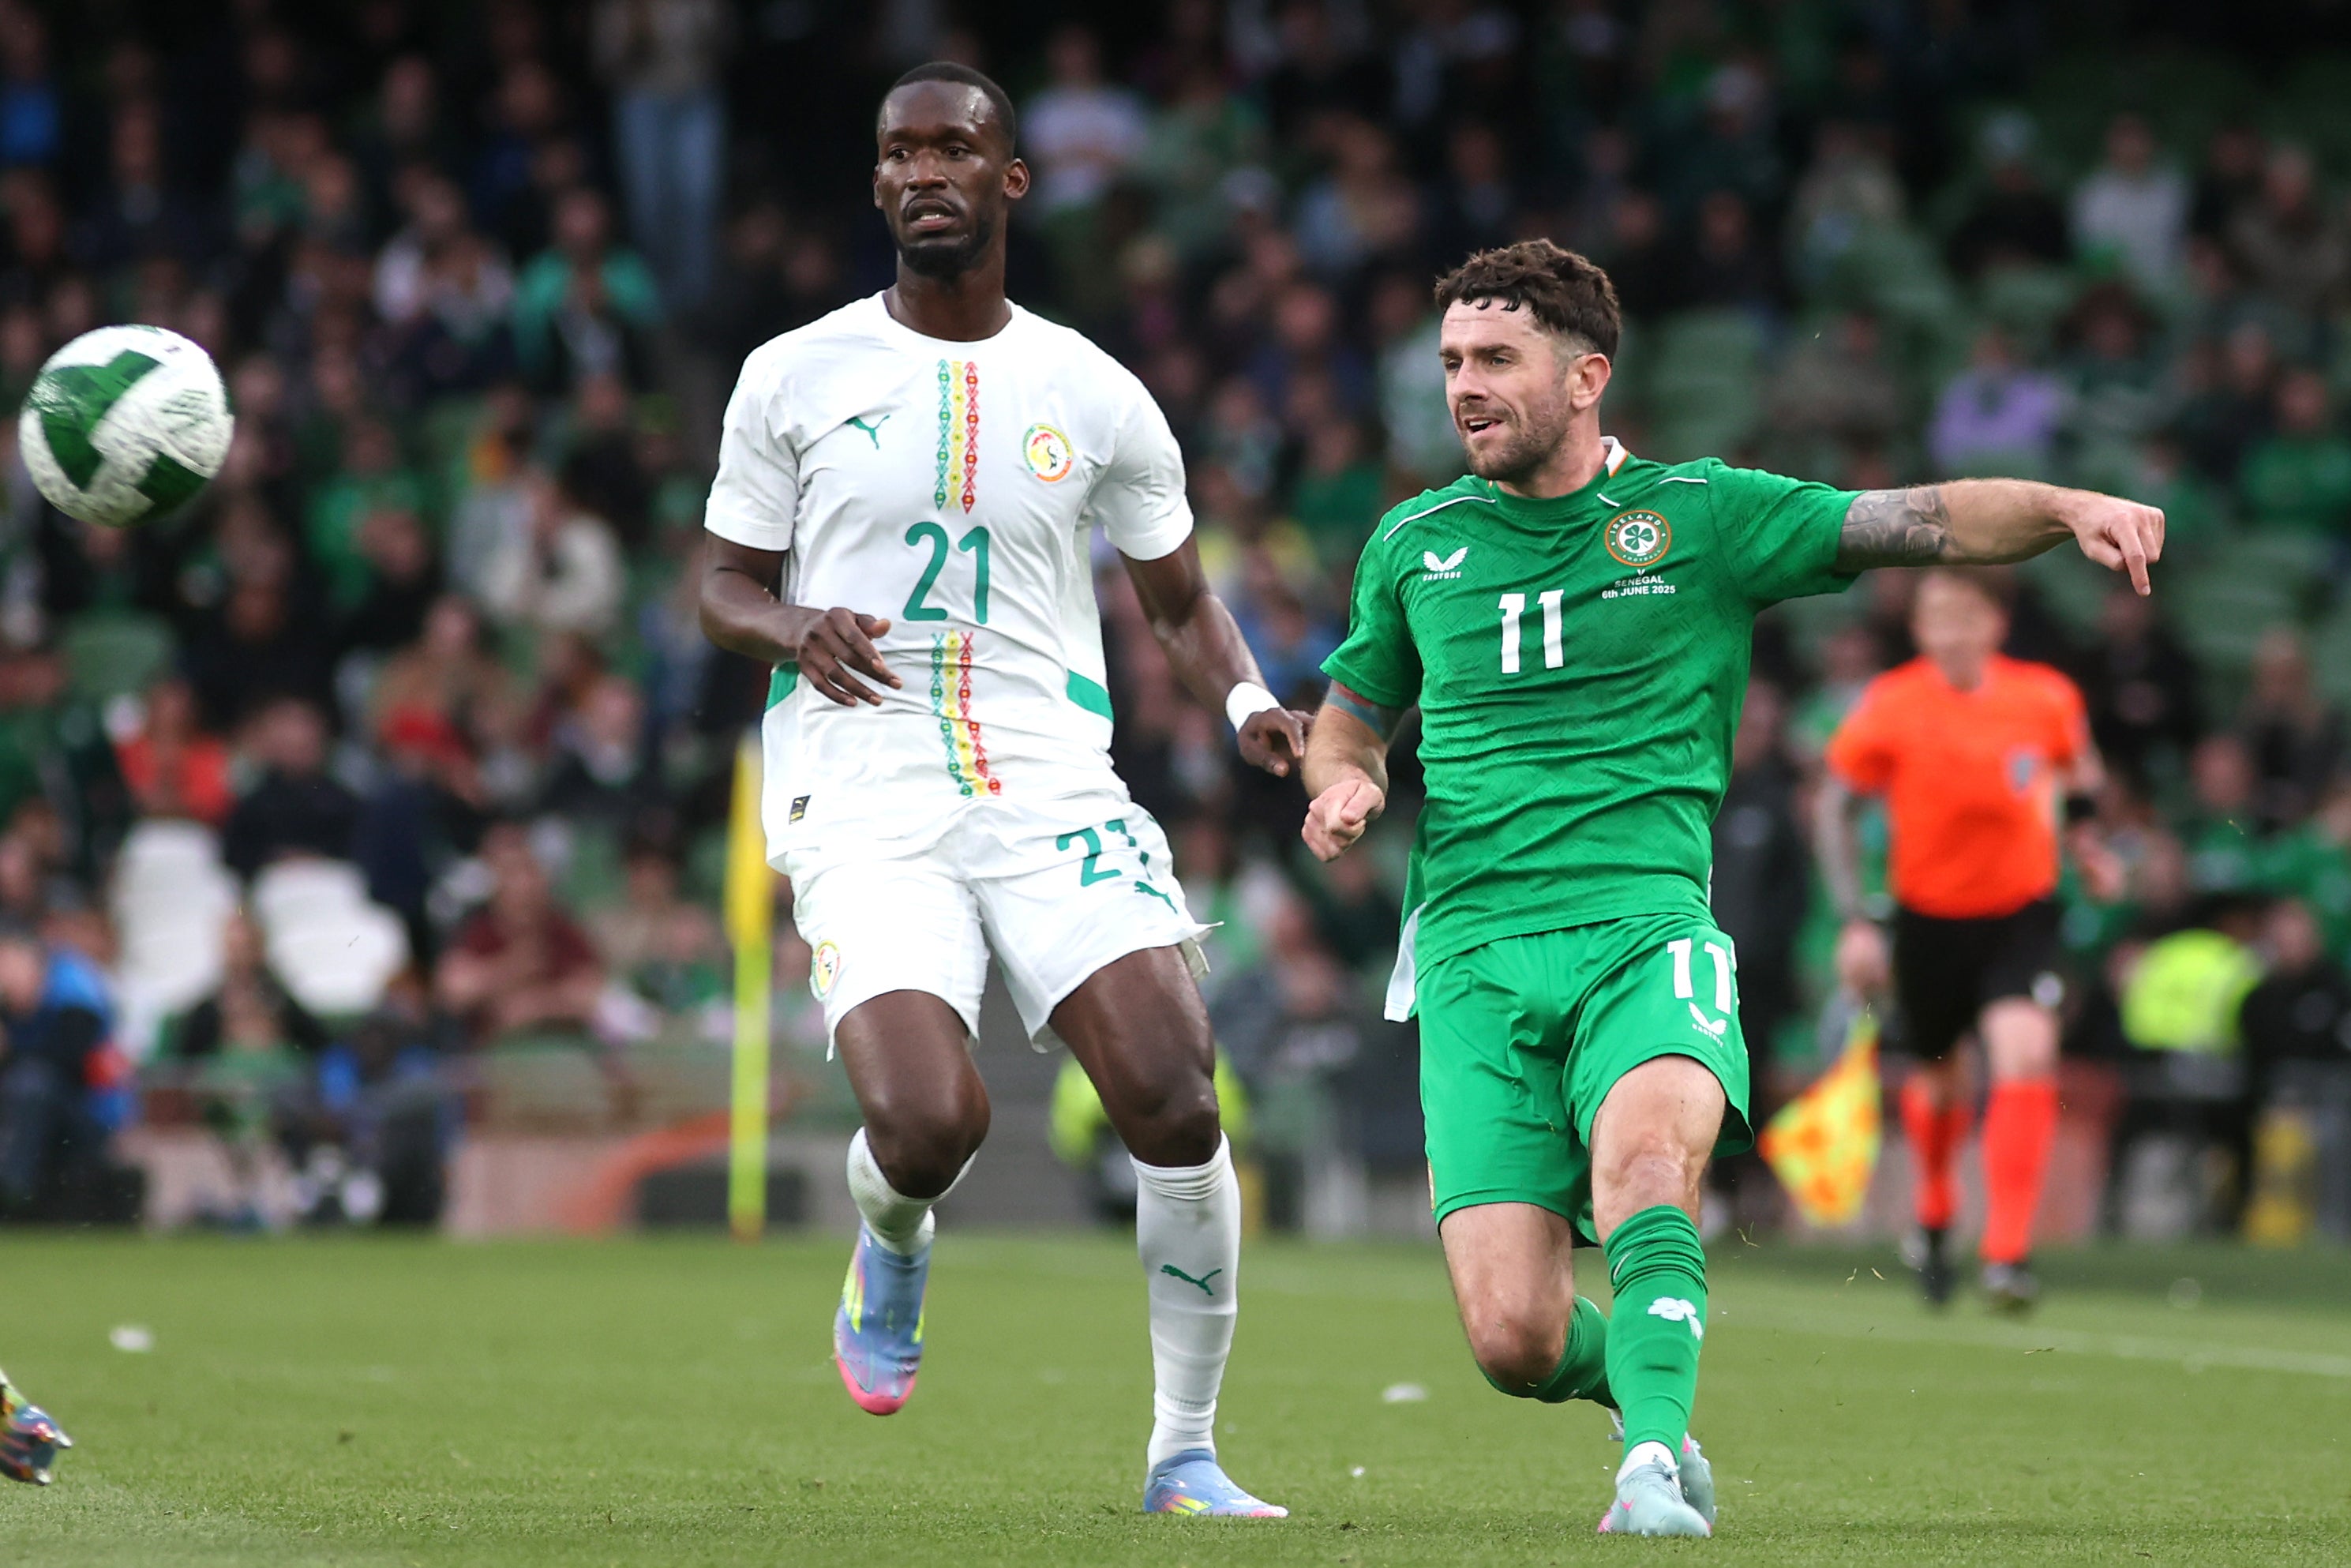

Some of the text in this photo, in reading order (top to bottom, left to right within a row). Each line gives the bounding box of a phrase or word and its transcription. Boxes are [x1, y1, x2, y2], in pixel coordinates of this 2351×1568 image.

[1610, 513, 1661, 534] IRELAND
[902, 521, 989, 625] 21
[1602, 585, 1676, 599] 6th JUNE 2025
[1614, 576, 1664, 588] SENEGAL
[1498, 589, 1564, 673] 11
[1667, 937, 1731, 1015] 11
